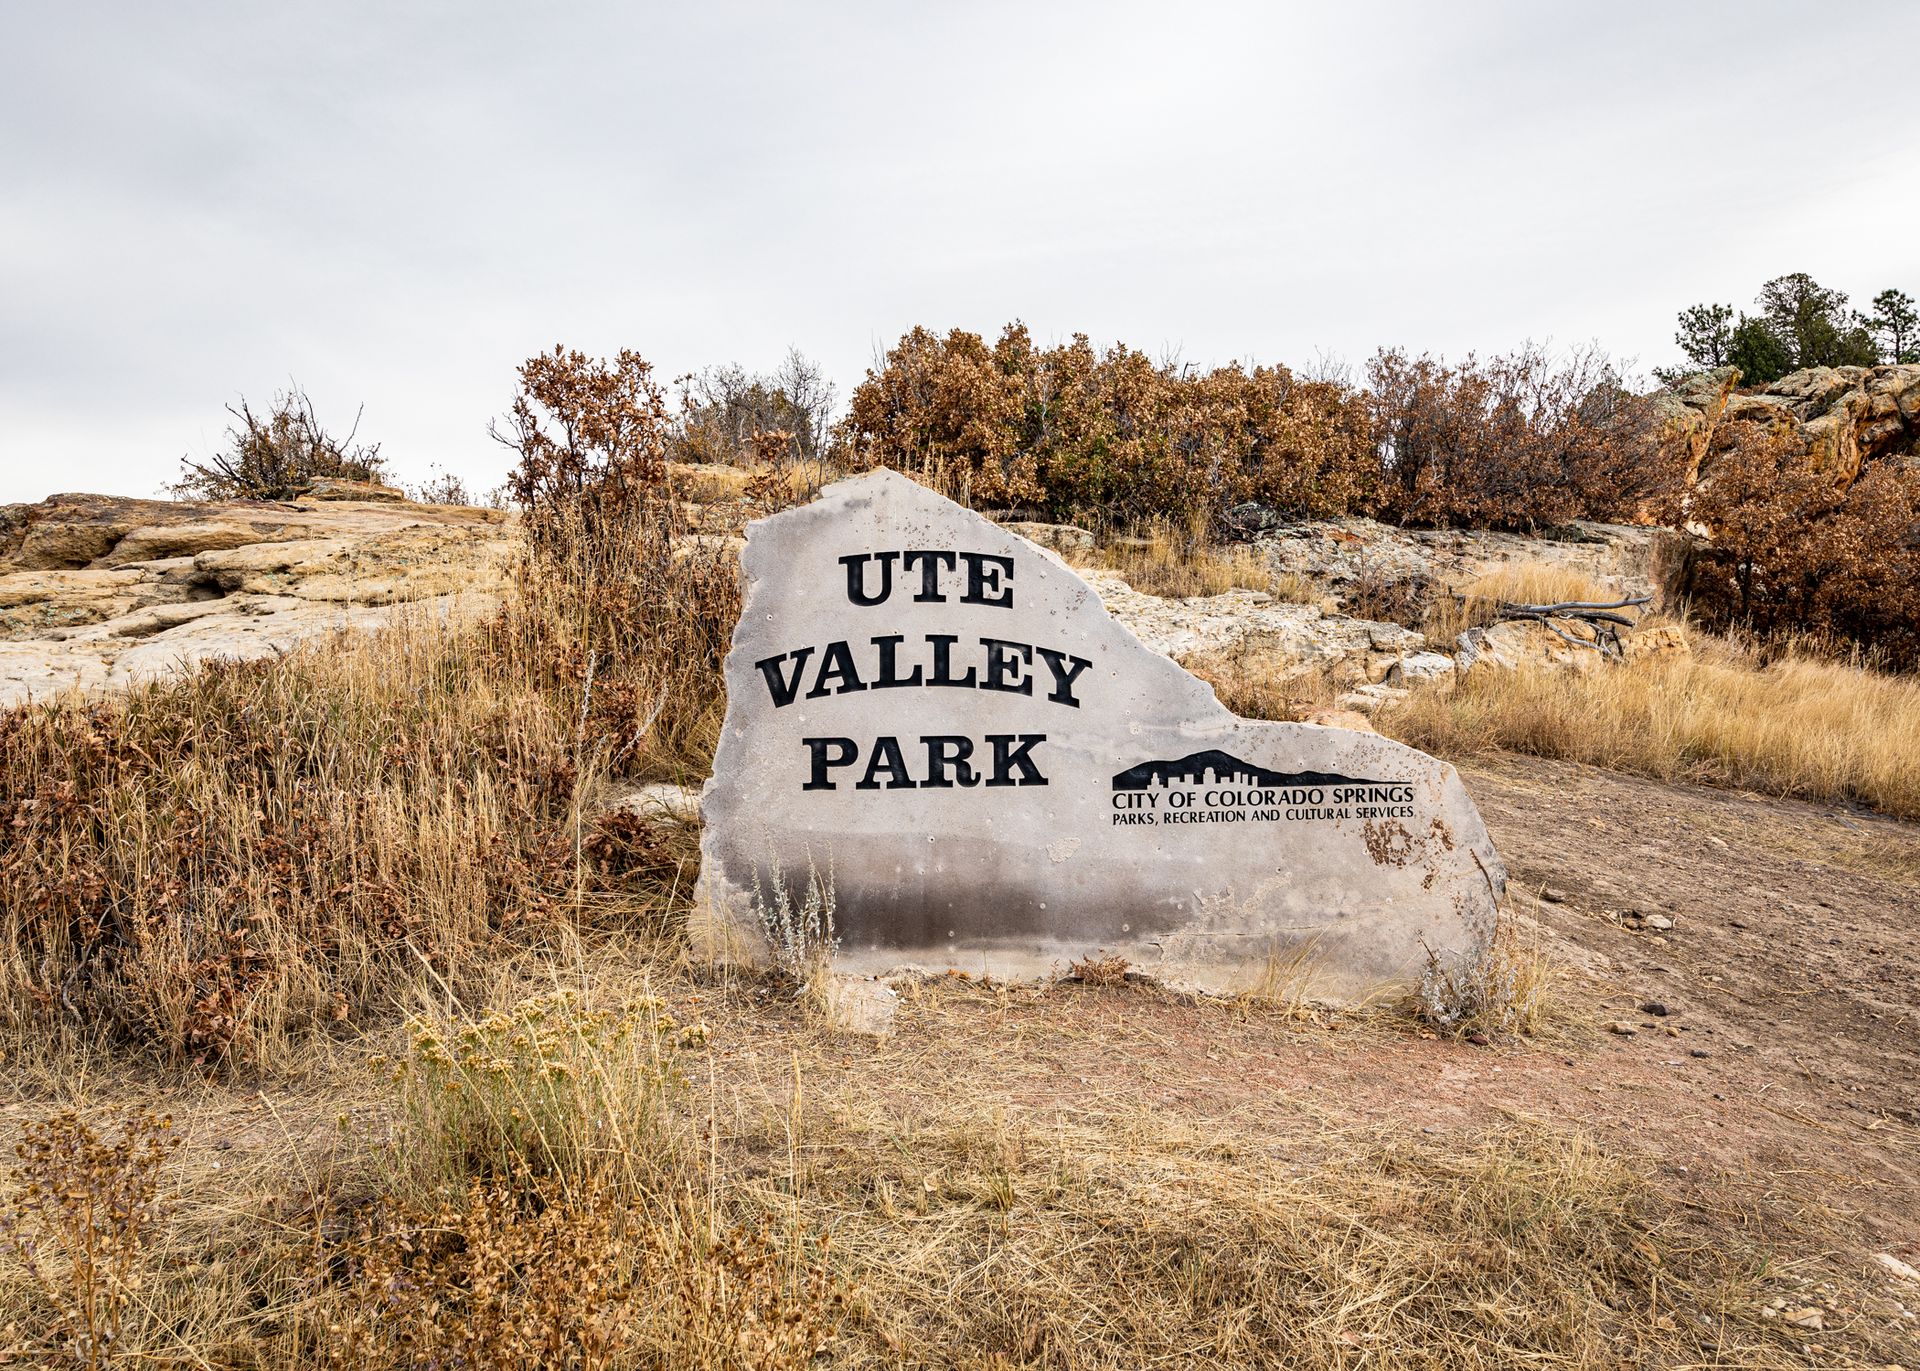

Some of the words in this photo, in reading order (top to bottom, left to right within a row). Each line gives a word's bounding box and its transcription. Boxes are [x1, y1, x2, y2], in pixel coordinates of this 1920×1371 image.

[838, 550, 1015, 609] UTE
[754, 634, 1093, 708] VALLEY
[802, 733, 1049, 791] PARK
[1112, 792, 1160, 809] CITY
[1168, 791, 1197, 808] OF
[1204, 788, 1325, 807] COLORADO
[1332, 786, 1414, 804] SPRINGS
[1112, 812, 1159, 826] PARKS,
[1163, 810, 1246, 825] RECREATION
[1251, 809, 1281, 822] AND
[1285, 807, 1351, 821] CULTURAL
[1355, 805, 1414, 819] SERVICES
